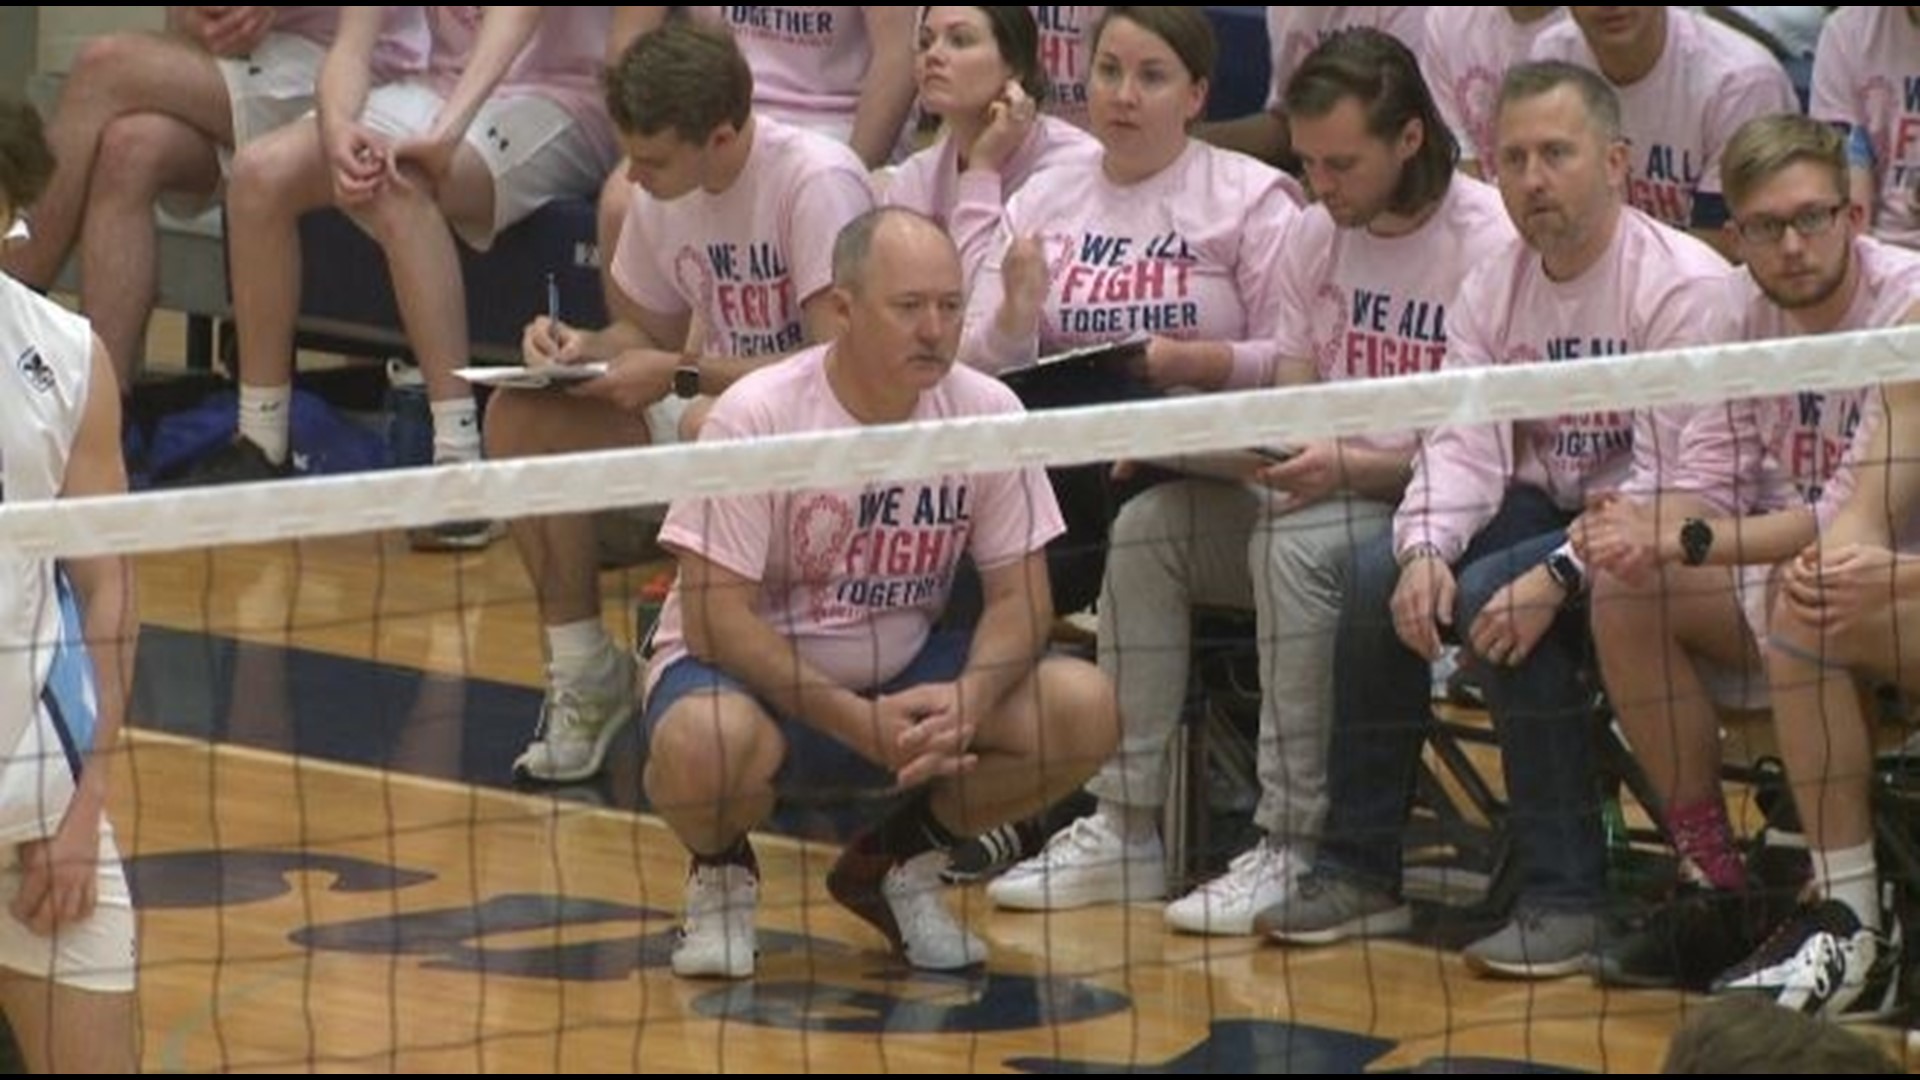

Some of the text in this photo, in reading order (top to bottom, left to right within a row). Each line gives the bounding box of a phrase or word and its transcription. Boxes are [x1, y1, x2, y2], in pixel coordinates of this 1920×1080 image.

[707, 243, 741, 282] WE
[1081, 232, 1132, 267] WE
[1061, 260, 1195, 305] FIGHT
[1059, 301, 1198, 333] TOGETHER
[1353, 288, 1448, 343] WE ALL
[1347, 330, 1448, 379] FIGHT
[857, 485, 970, 528] WE ALL
